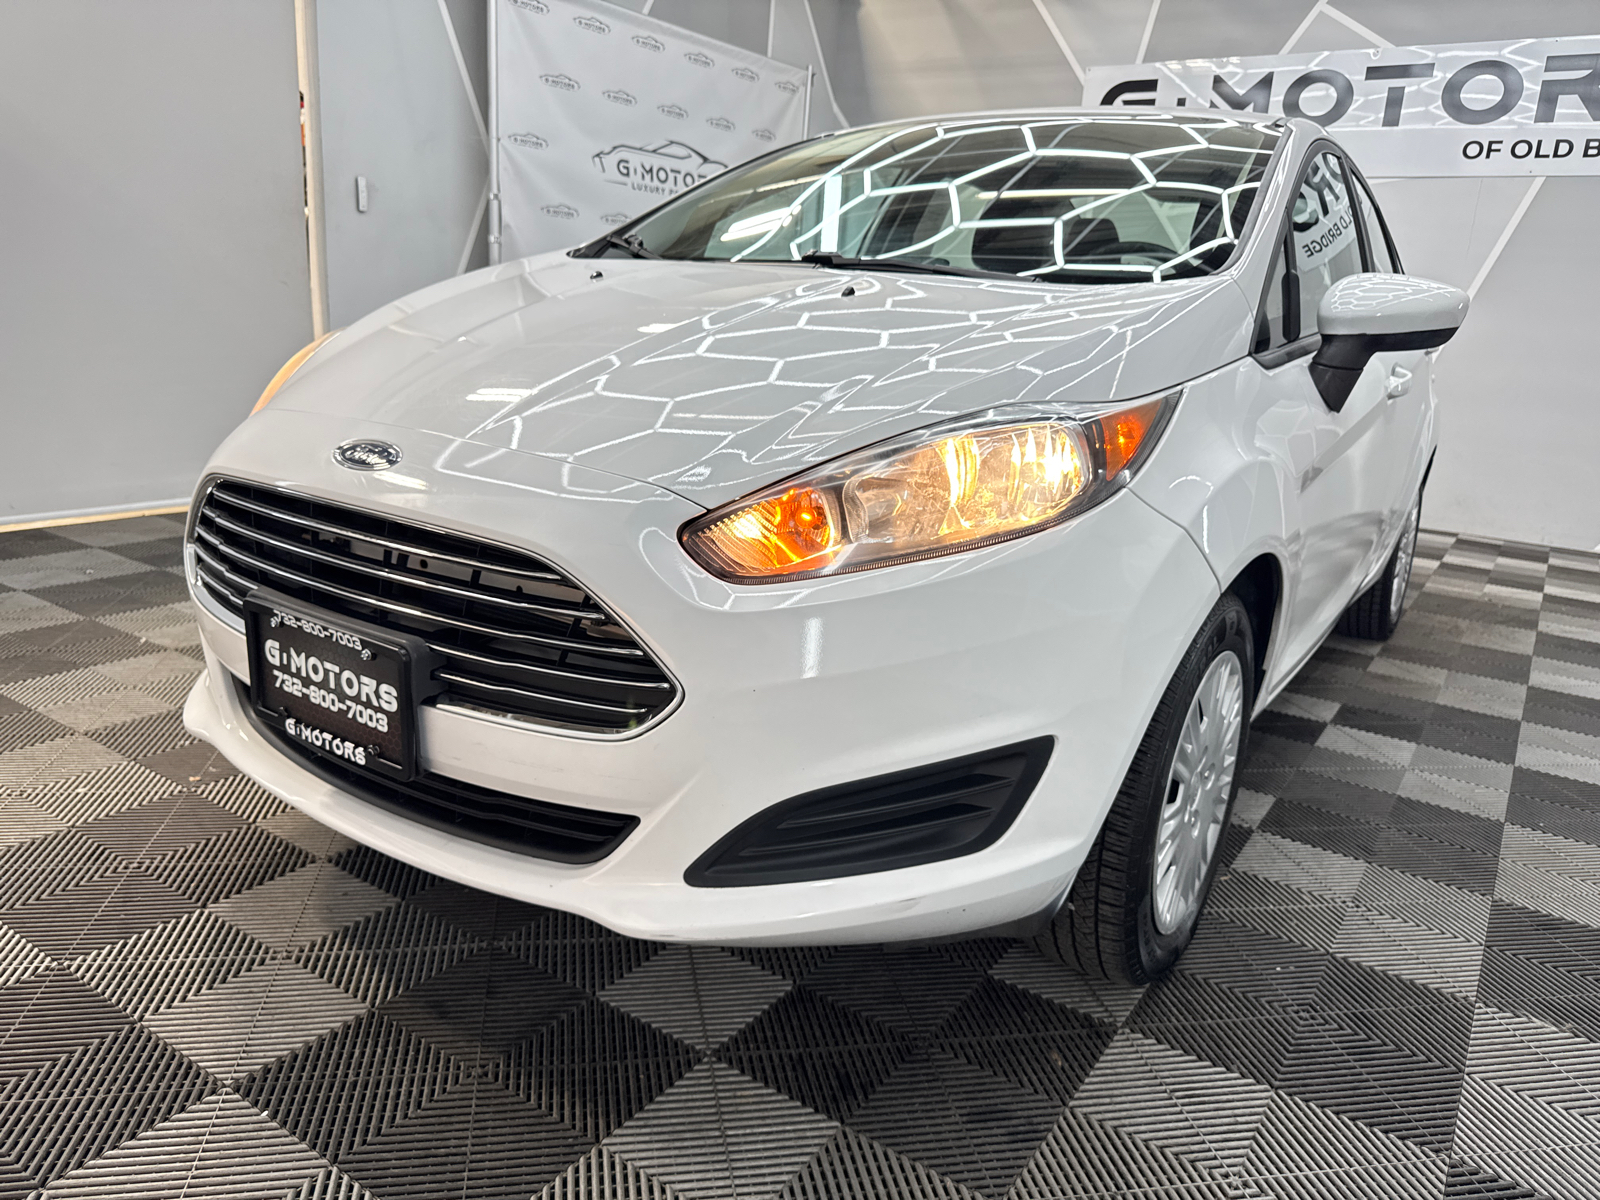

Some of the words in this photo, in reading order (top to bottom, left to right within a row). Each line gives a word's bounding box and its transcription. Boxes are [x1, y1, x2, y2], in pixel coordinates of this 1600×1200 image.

[1462, 140, 1503, 160] OF
[1510, 139, 1575, 159] OLD
[631, 181, 666, 196] LUXURY
[272, 609, 363, 651] 732-800-7003
[272, 669, 389, 733] 732-800-7003
